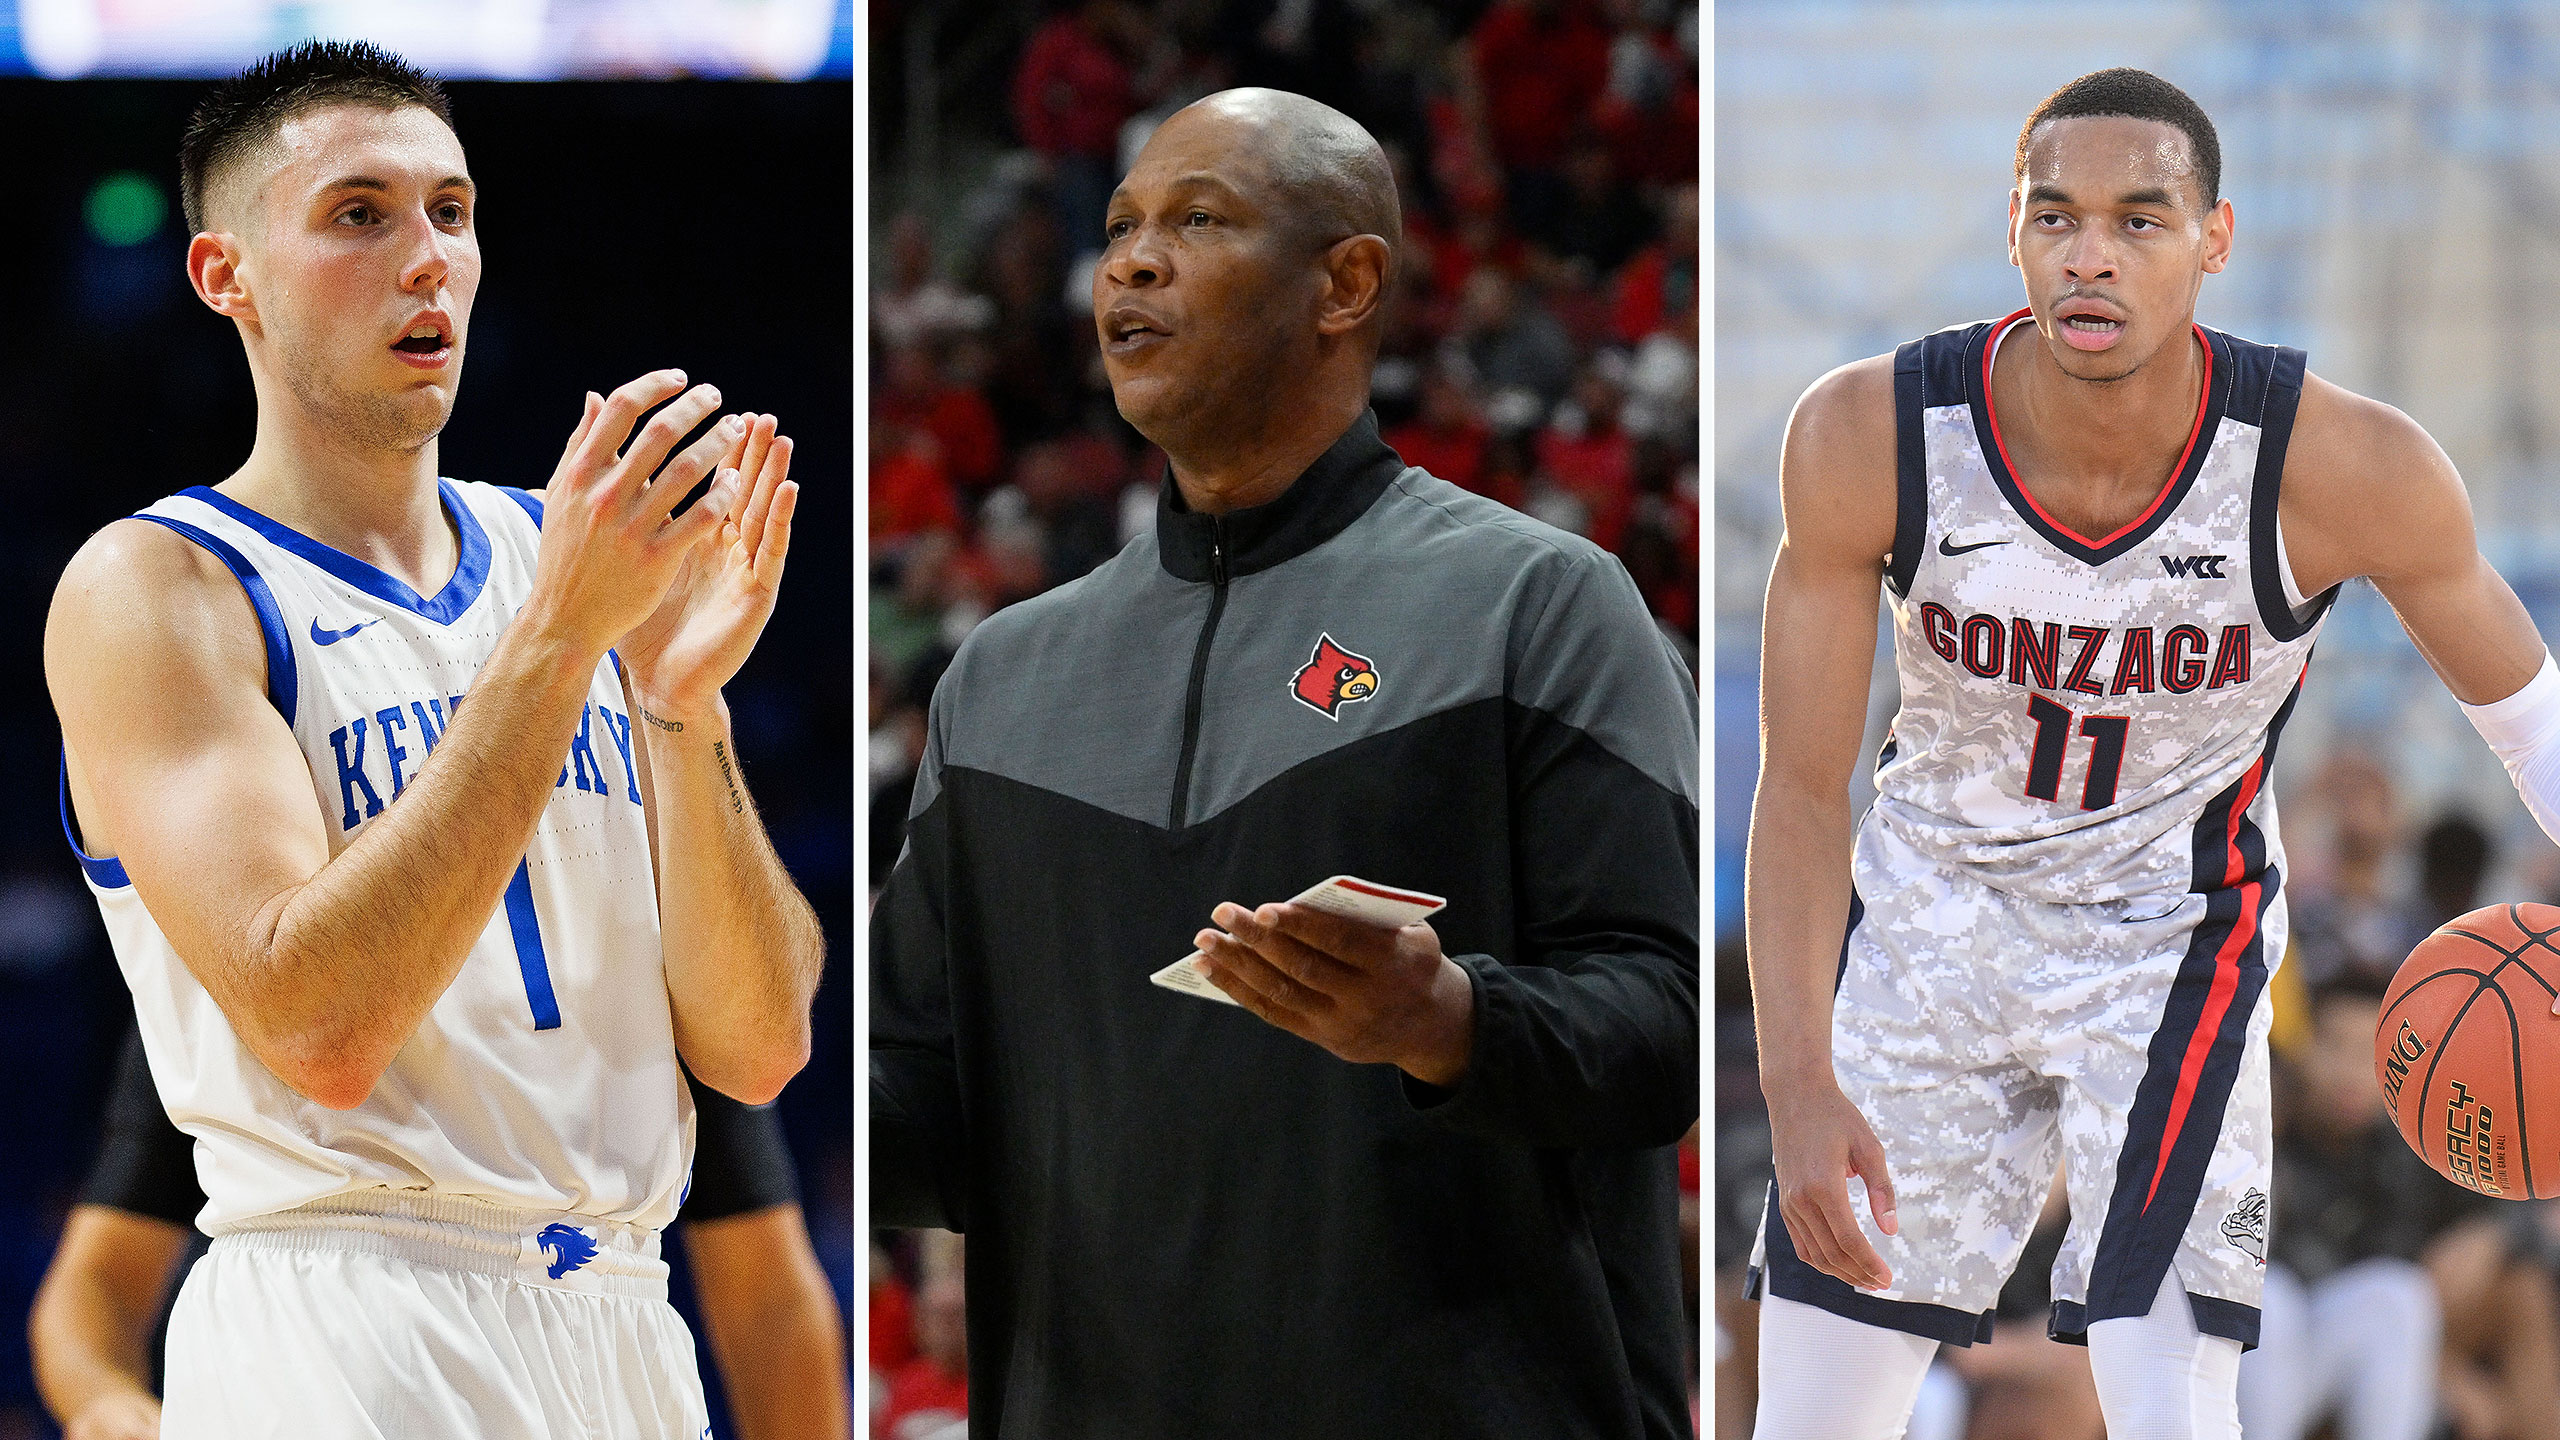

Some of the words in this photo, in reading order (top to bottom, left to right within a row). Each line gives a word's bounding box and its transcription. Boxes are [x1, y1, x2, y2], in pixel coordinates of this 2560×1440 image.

[2159, 555, 2227, 579] WCC
[1920, 602, 2251, 697] GONZAGA
[329, 695, 642, 832] KENKY
[644, 710, 684, 732] SECOND
[2024, 692, 2131, 812] 11
[2384, 1018, 2427, 1122] DING
[2446, 1080, 2482, 1192] EGACY
[2496, 1134, 2506, 1151] BALL
[2497, 1151, 2506, 1169] GAME
